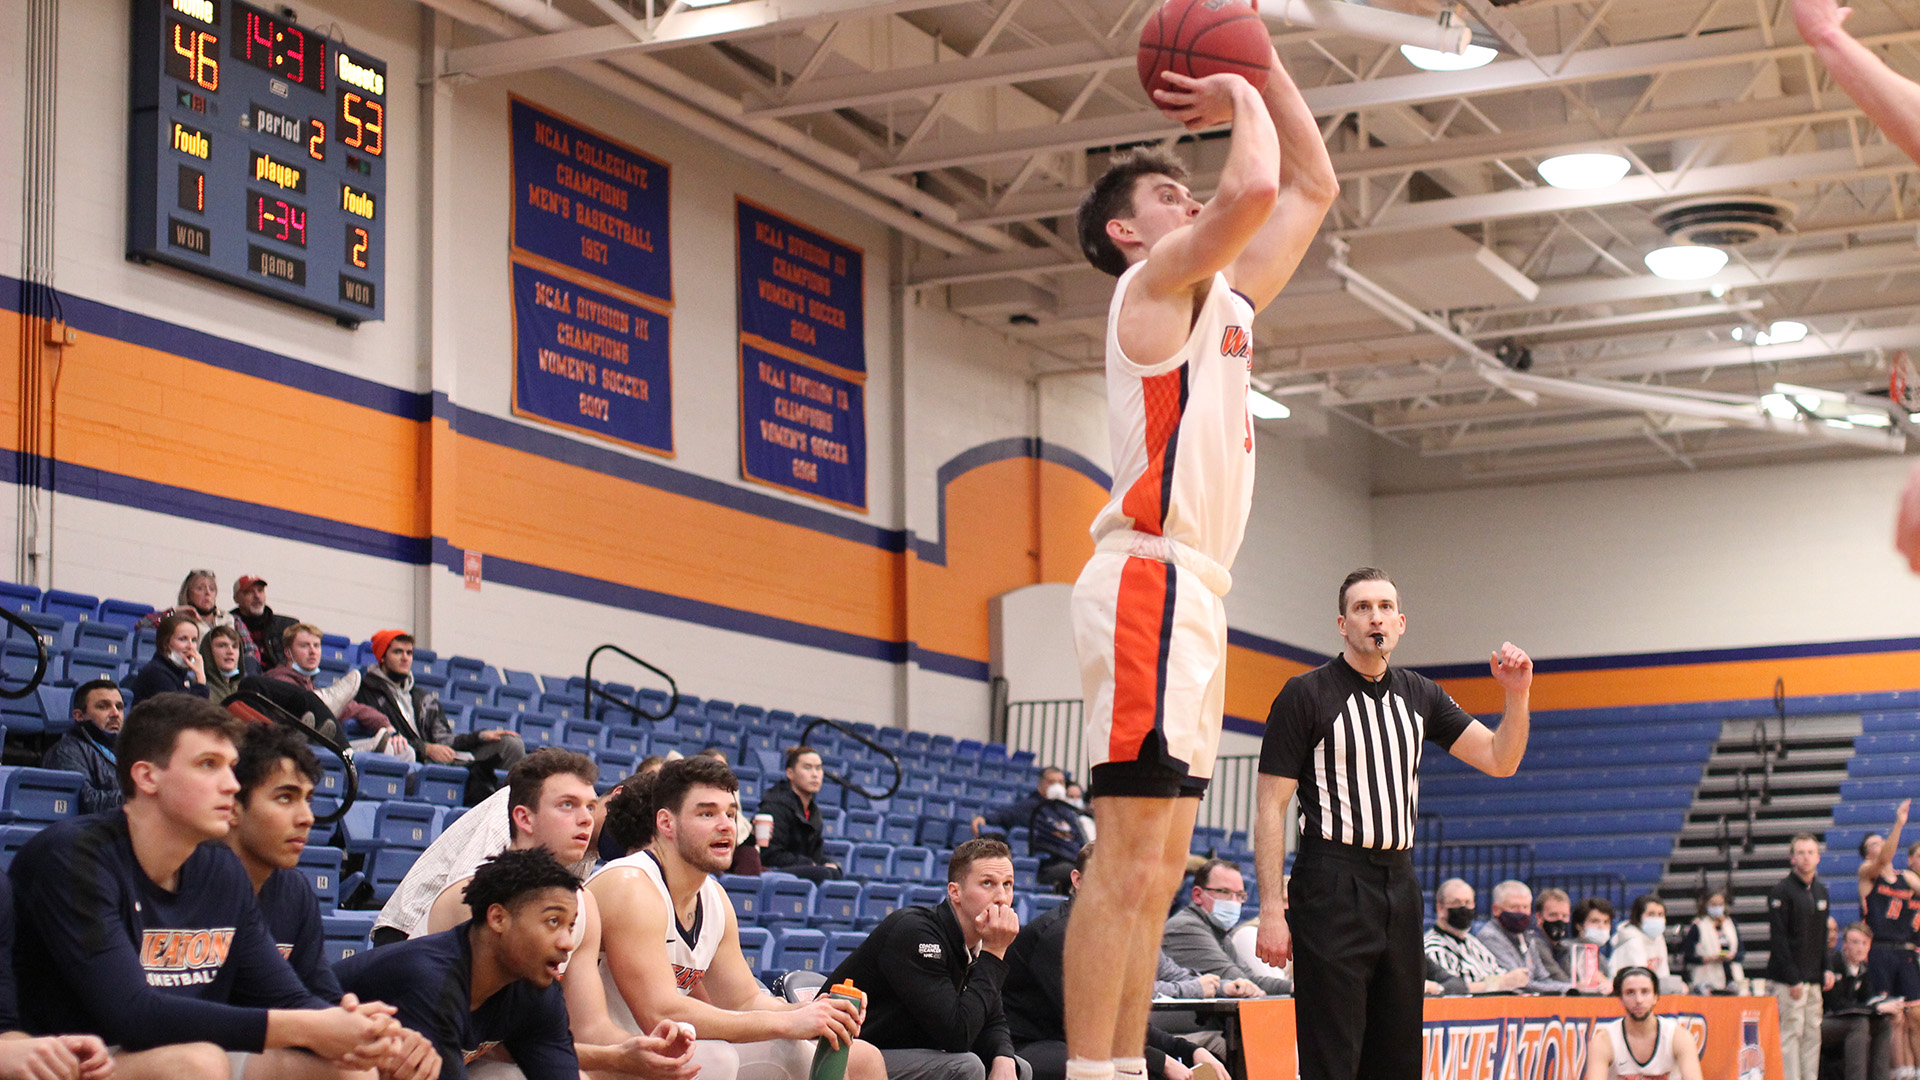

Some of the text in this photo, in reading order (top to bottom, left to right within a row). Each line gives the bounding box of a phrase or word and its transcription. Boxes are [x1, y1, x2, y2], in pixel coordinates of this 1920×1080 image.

[174, 24, 218, 91] 46
[247, 12, 325, 90] 14:31
[339, 53, 383, 95] Guests
[174, 123, 209, 160] fouls
[257, 110, 325, 160] period 2
[343, 92, 384, 156] 53
[256, 154, 300, 189] player
[535, 121, 648, 189] NCAA COLLEGIATE
[198, 175, 204, 211] 1
[343, 185, 374, 220] fouls
[557, 163, 628, 211] CHAMPIONS
[176, 224, 204, 251] won
[529, 183, 653, 253] MEN'S BASKETBALL
[756, 221, 784, 249] NCAA
[261, 253, 294, 280] game
[352, 227, 368, 268] 2
[345, 279, 370, 305] won
[773, 256, 830, 296] CHAMPIONS
[535, 281, 648, 341] NCAA DIVISION III
[758, 278, 846, 330] WOMEN'S SOCCER
[557, 322, 629, 364] CHAMPIONS
[538, 347, 649, 401] WOMEN'S SOCCER
[759, 361, 786, 390] NCAA
[579, 392, 609, 421] 2007
[775, 396, 833, 433] CHAMPIONS
[760, 419, 848, 464] WOMEN'S SOCCER
